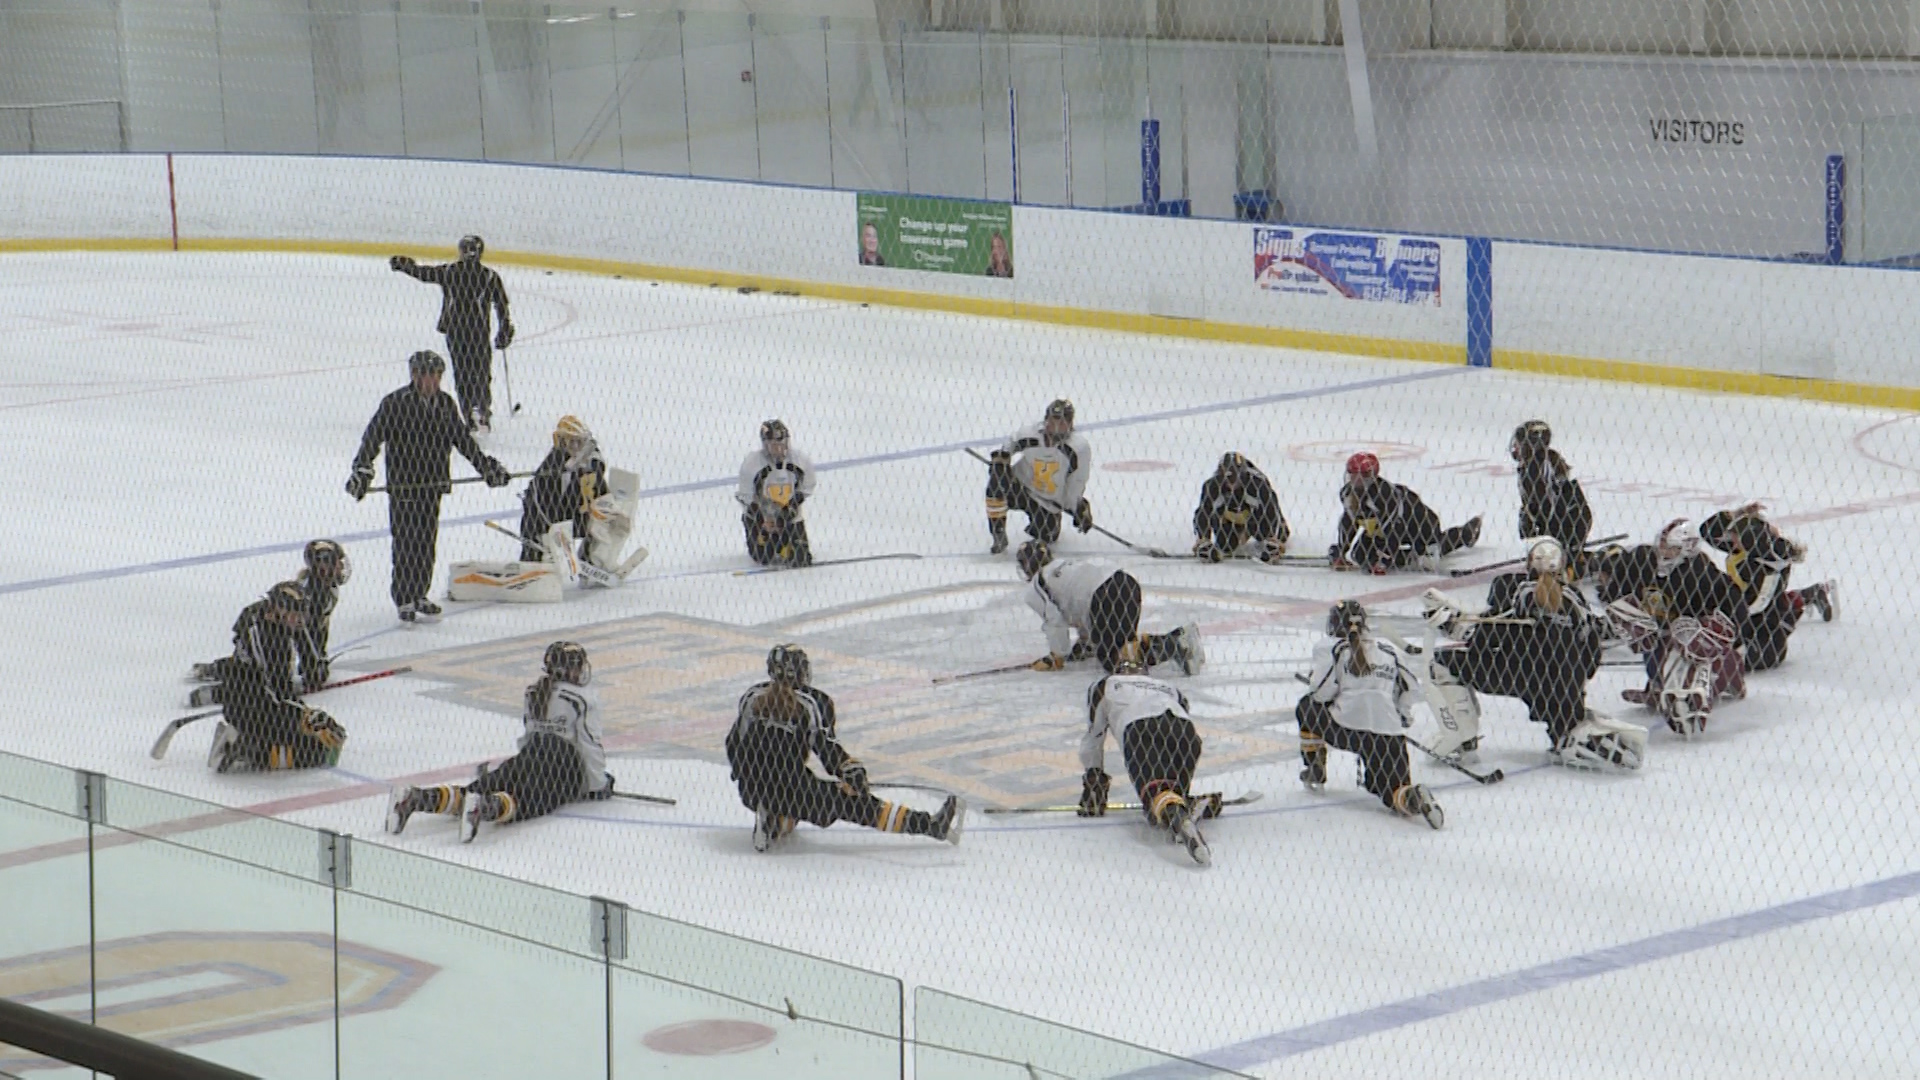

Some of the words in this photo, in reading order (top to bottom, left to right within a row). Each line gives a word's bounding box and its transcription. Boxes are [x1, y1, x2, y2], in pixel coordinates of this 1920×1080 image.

[1649, 119, 1745, 145] VISITORS
[899, 216, 932, 232] Change
[934, 223, 946, 233] up
[947, 224, 968, 234] your
[899, 231, 942, 246] insurance
[943, 238, 968, 250] game
[1256, 230, 1305, 262] Signs
